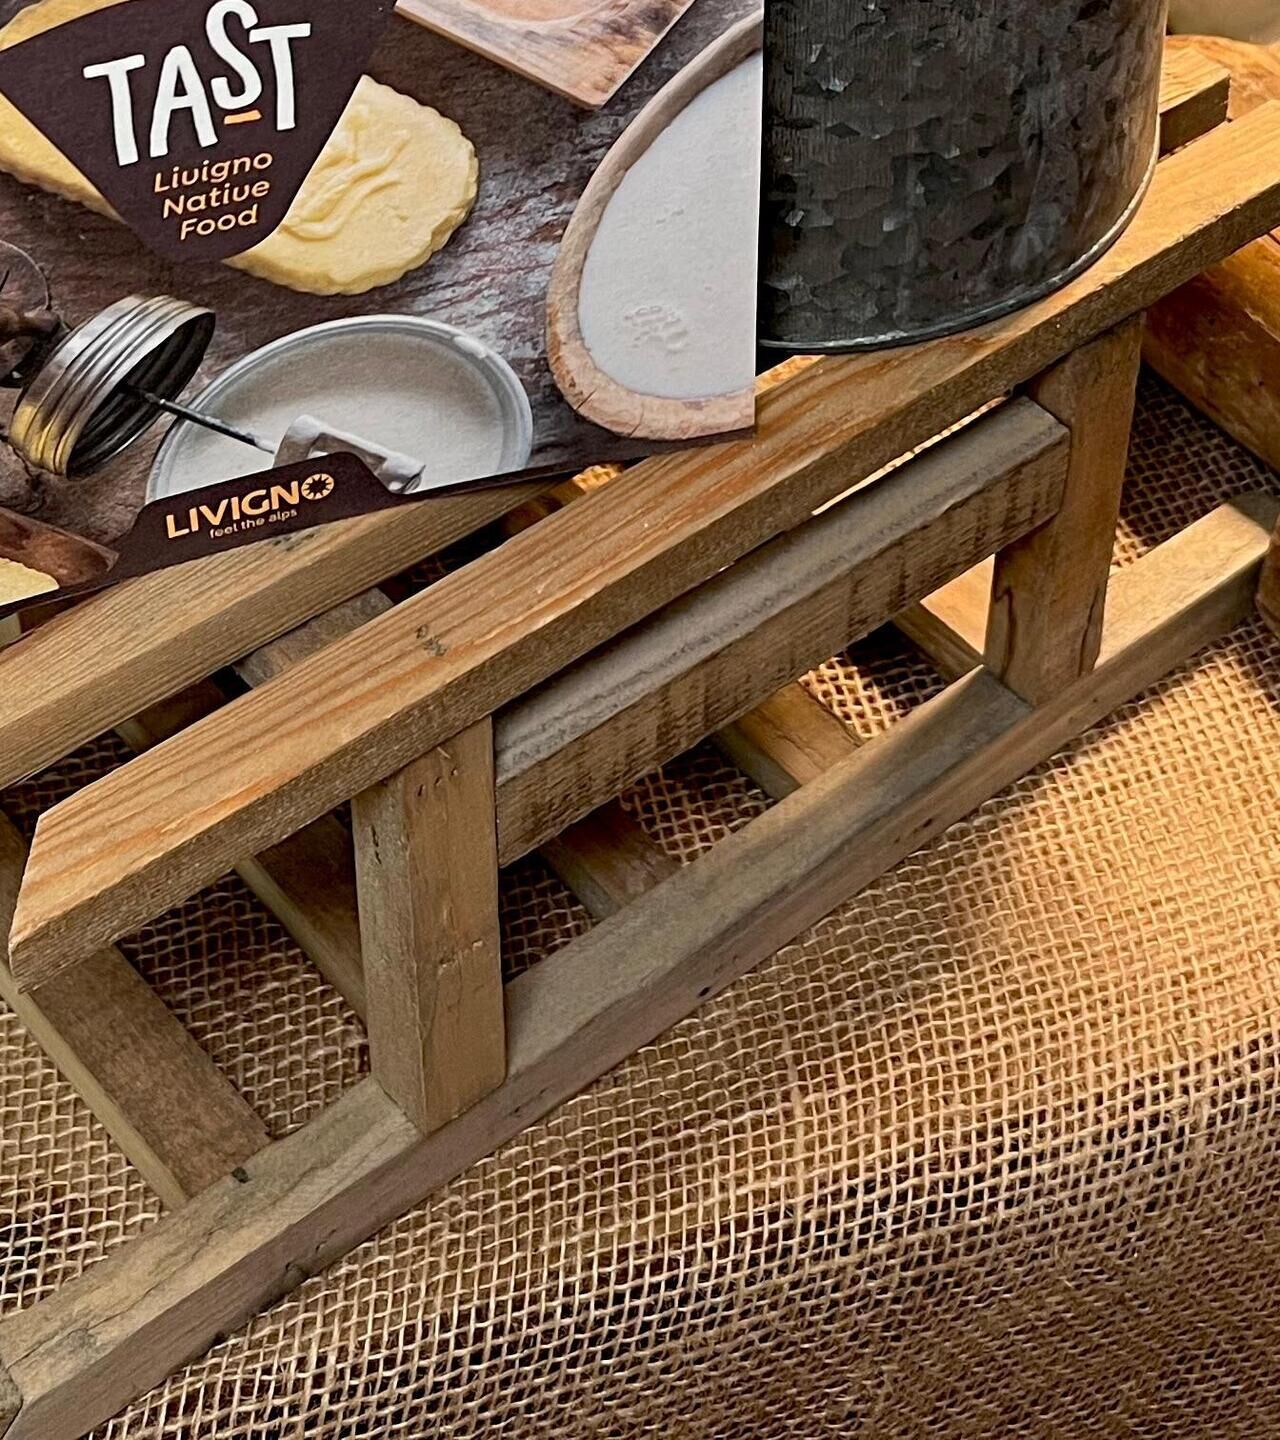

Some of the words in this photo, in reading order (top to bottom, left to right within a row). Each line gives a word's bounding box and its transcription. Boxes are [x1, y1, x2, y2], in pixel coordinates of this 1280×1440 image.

[153, 152, 273, 193] Livigno
[162, 179, 271, 219] Native
[180, 204, 259, 241] Food
[166, 473, 335, 539] LIVIGNO
[210, 523, 238, 540] feel
[240, 516, 265, 531] the
[268, 509, 298, 525] alps
